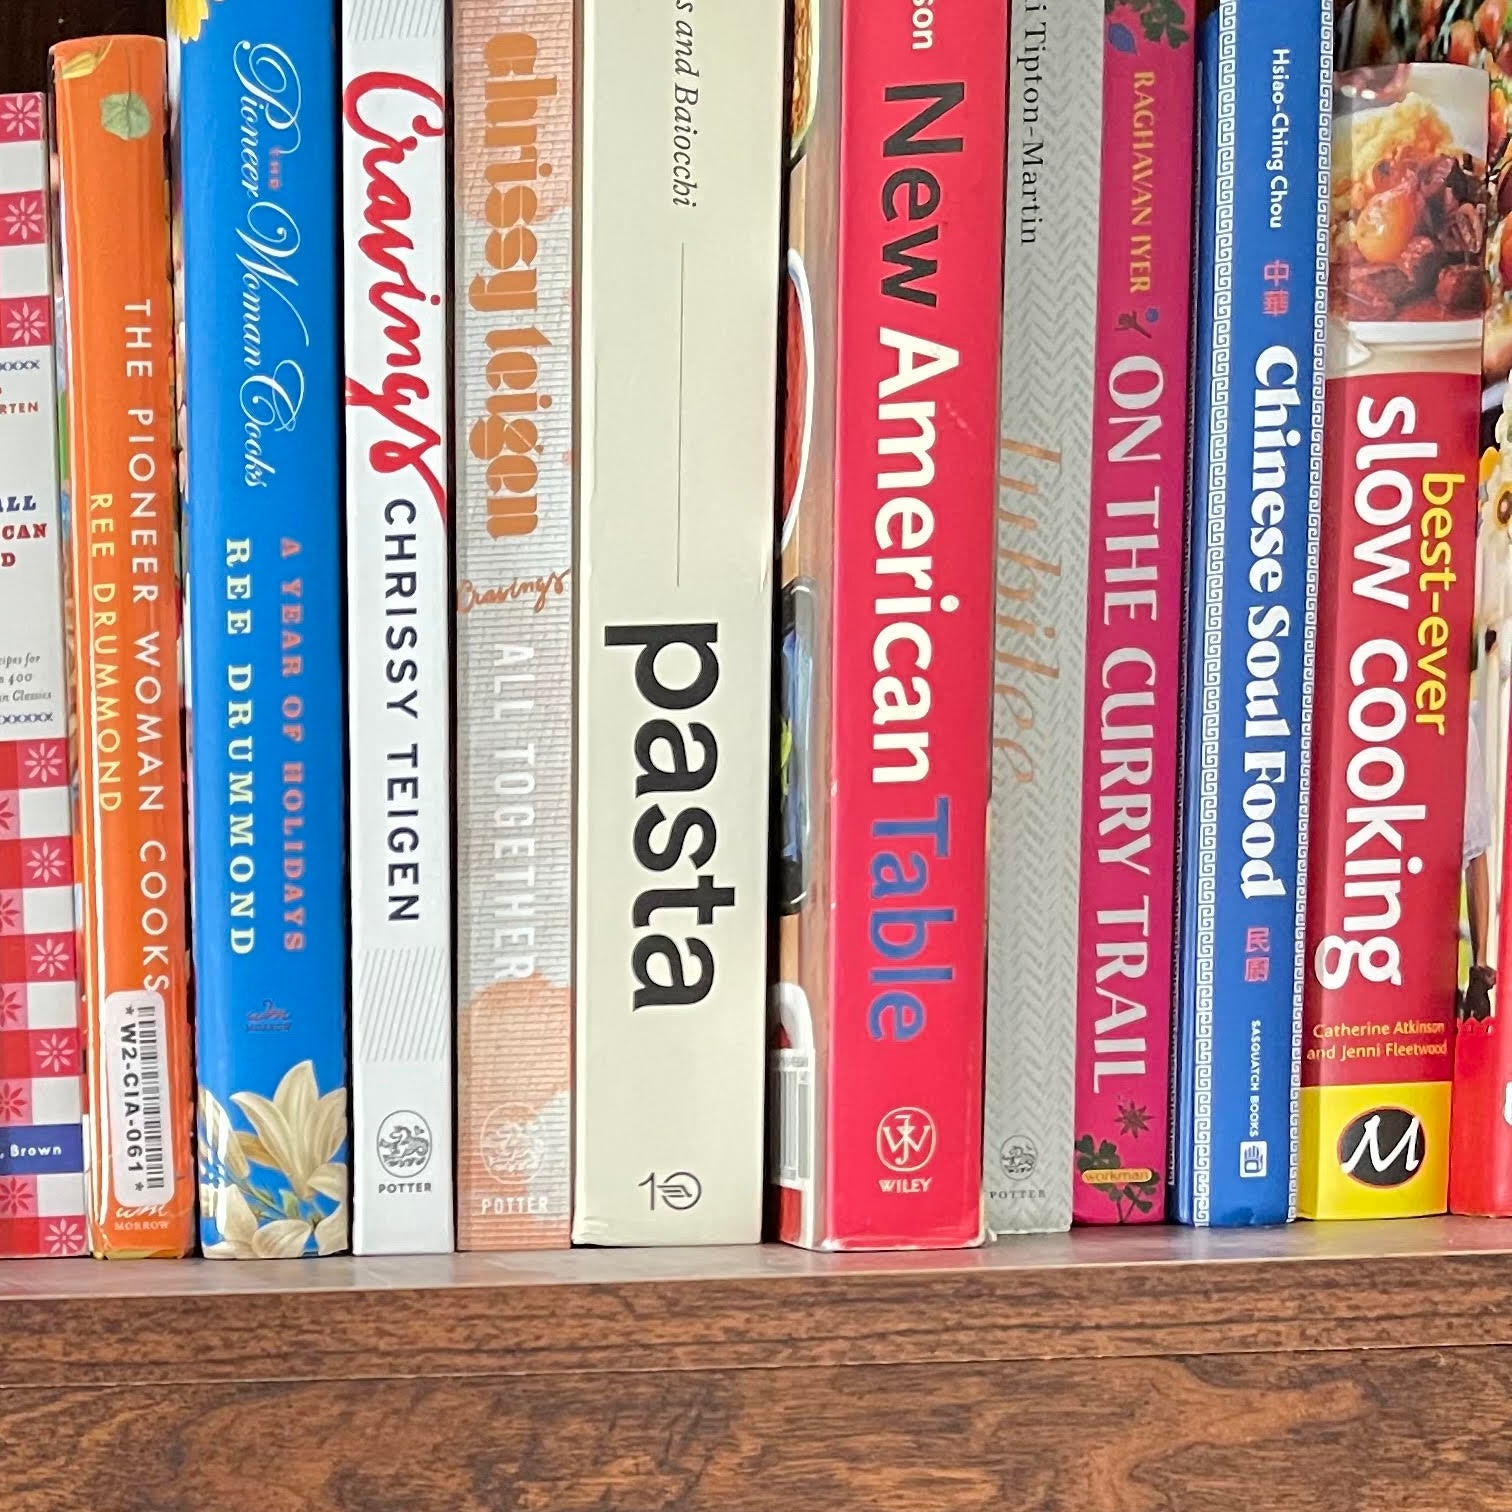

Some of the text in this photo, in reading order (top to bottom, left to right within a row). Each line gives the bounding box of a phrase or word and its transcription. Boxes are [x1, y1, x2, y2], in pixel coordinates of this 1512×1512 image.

[673, 27, 700, 209] and Baiocchi
[1016, 21, 1046, 246] Tipton-Martin
[1266, 47, 1291, 229] Hsiao-Ching Chou
[124, 299, 169, 991] THE PIONEER WOMAN COOKS
[868, 82, 963, 1041] New American Table
[1240, 344, 1299, 899] Chinese Soul Food
[1313, 395, 1439, 990] slow cooking
[1415, 472, 1466, 736] best-ever
[226, 538, 254, 954] REE DRUMMOND
[384, 499, 420, 921] CHRISSY TEIGEN
[604, 622, 736, 1012] pasta
[1092, 354, 1165, 1094] ON THE CURRY TRAIL
[122, 1023, 144, 1174] W2-CIA-061
[1249, 1020, 1261, 1137] SASQUATCH BOOKS
[1306, 1040, 1448, 1060] and Jenni Fleetwood
[1313, 1022, 1445, 1037] Catherine Atkinson
[378, 1183, 432, 1193] POTTER
